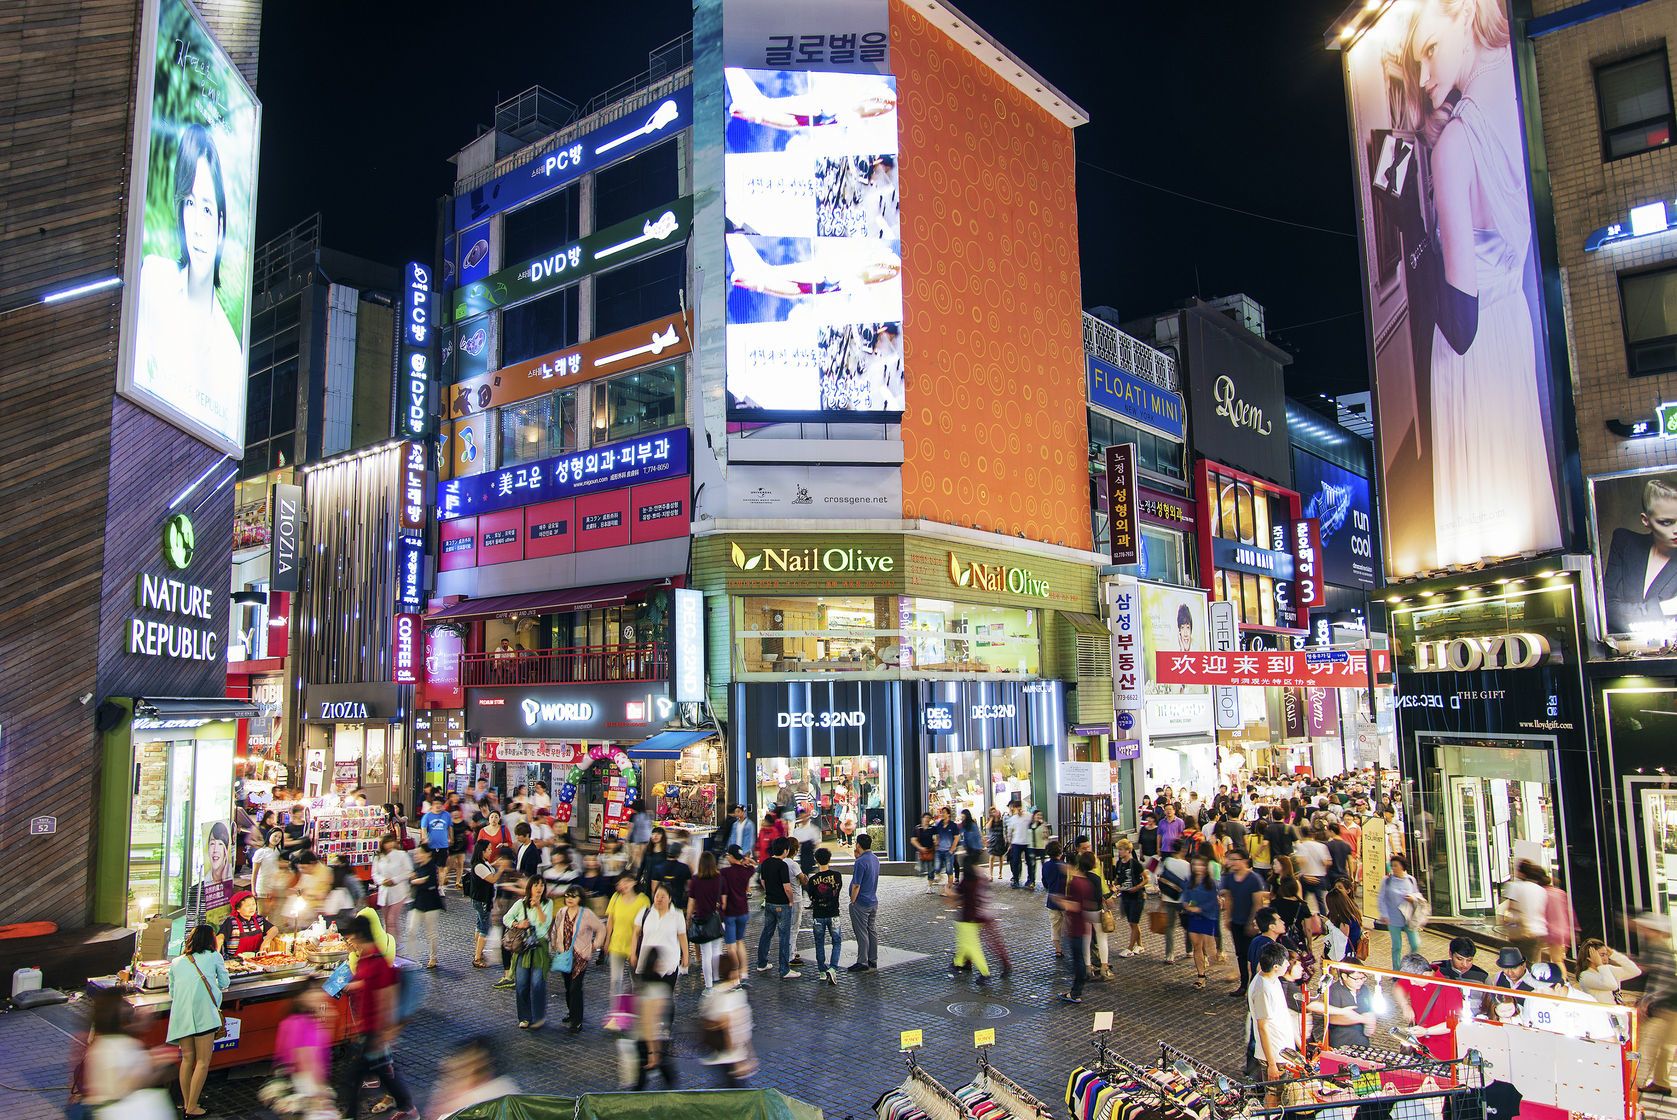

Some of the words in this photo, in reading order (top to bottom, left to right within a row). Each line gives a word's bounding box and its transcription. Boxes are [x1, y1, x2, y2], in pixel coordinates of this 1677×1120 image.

[765, 31, 887, 65] 글로벌을
[546, 144, 583, 177] PC방
[531, 246, 581, 282] DVD방
[411, 291, 426, 341] PC방
[542, 353, 581, 379] 노래방
[410, 380, 425, 433] DVD방
[1095, 368, 1147, 408] FLOATI
[1152, 395, 1179, 423] MINI
[1213, 374, 1272, 436] Roem
[1113, 453, 1126, 487] 노정식
[407, 472, 423, 523] 노래방
[823, 494, 888, 506] crossgene.net
[1113, 487, 1131, 548] 성형외과
[1352, 508, 1370, 533] run
[278, 499, 296, 575] ZIOZIA
[1350, 534, 1372, 558] cool
[762, 547, 818, 572] Nail
[822, 547, 895, 573] Olive
[969, 561, 1008, 593] Nail
[1007, 567, 1050, 598] Olive
[140, 573, 213, 620] NATURE
[130, 619, 217, 661] REPUBLIC
[398, 617, 412, 668] COFFEE
[1412, 632, 1551, 674] LLOYD
[321, 702, 368, 719] ZIOZIA
[1456, 691, 1478, 700] THE
[1479, 690, 1506, 699] GIFT
[541, 703, 593, 721] WORLD
[777, 711, 866, 728] DEC.32ND
[927, 706, 952, 719] DEC.
[927, 719, 952, 730] 32ND
[971, 704, 1016, 720] DEC.32ND
[1519, 719, 1574, 730] www.lloydgift.com
[38, 824, 49, 832] 52
[1537, 1011, 1551, 1024] 99
